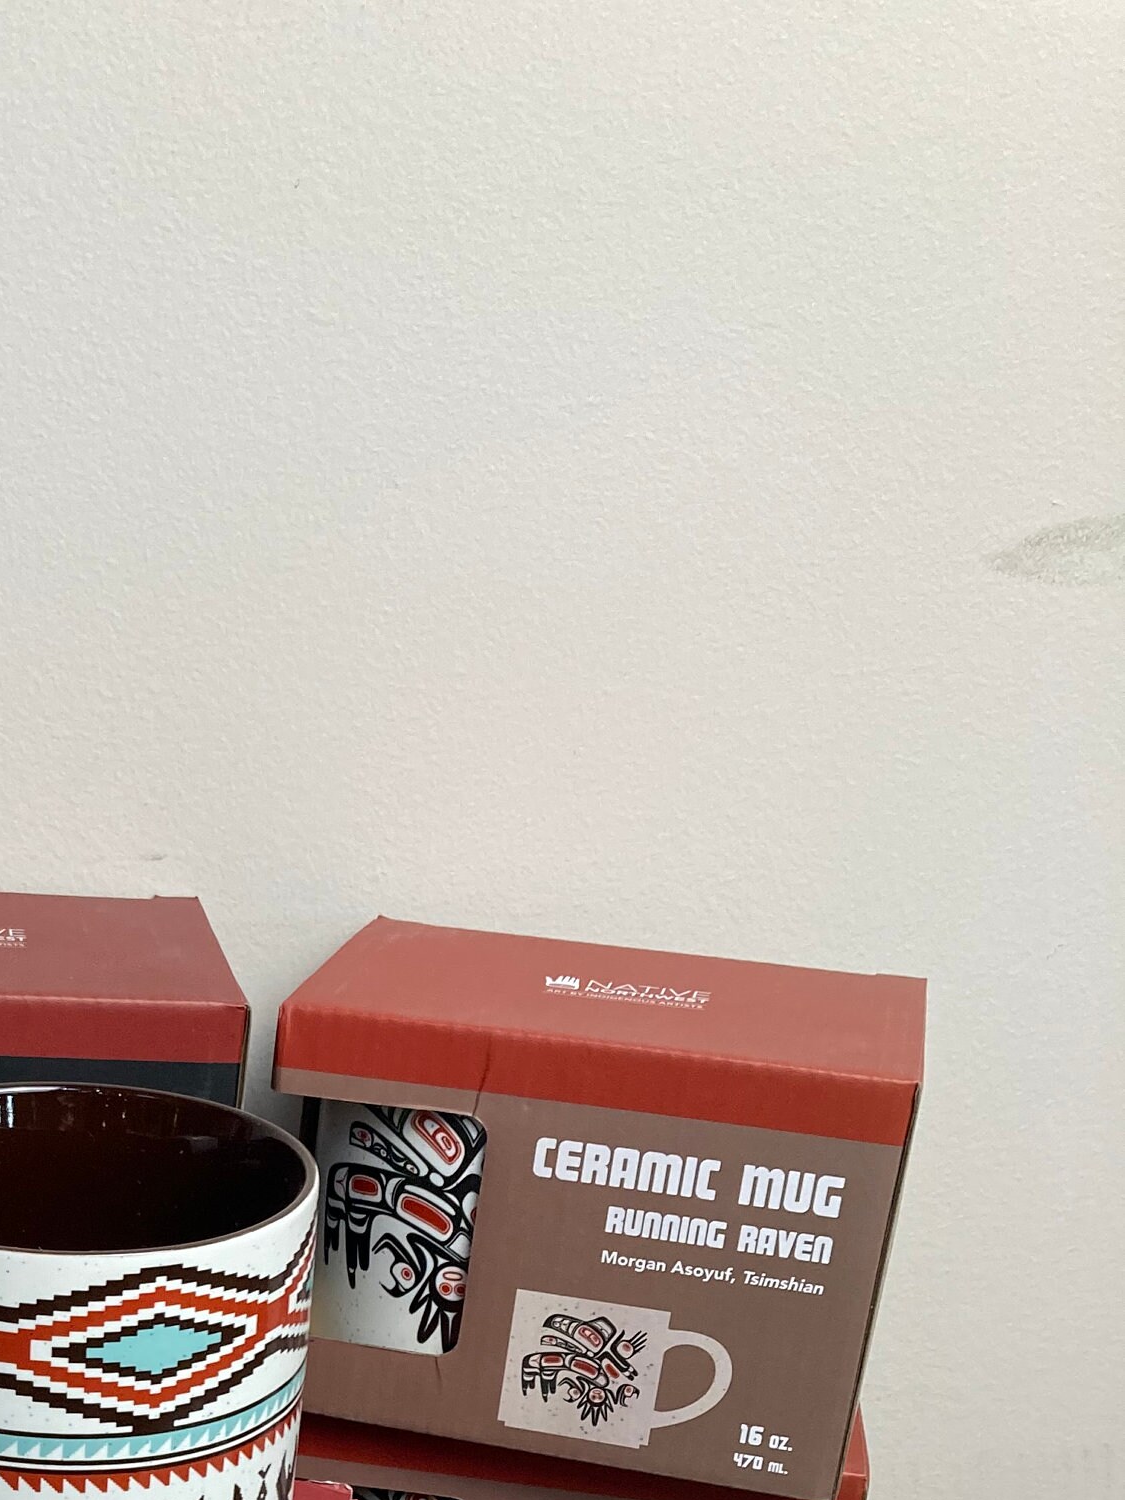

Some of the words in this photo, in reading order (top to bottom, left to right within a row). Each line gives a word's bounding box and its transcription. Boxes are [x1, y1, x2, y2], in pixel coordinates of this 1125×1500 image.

[585, 987, 709, 1004] NORTHWEST
[587, 980, 711, 998] NATIVE
[533, 1137, 722, 1201] CERAMIC
[737, 1165, 846, 1218] MUG
[604, 1206, 727, 1249] RUNNING
[737, 1224, 833, 1264] RAVEN
[601, 1250, 666, 1273] Morgan
[670, 1260, 735, 1284] Asoyuf,
[743, 1271, 824, 1295] Tsimshian
[739, 1424, 764, 1446] 16
[733, 1452, 763, 1470] 470
